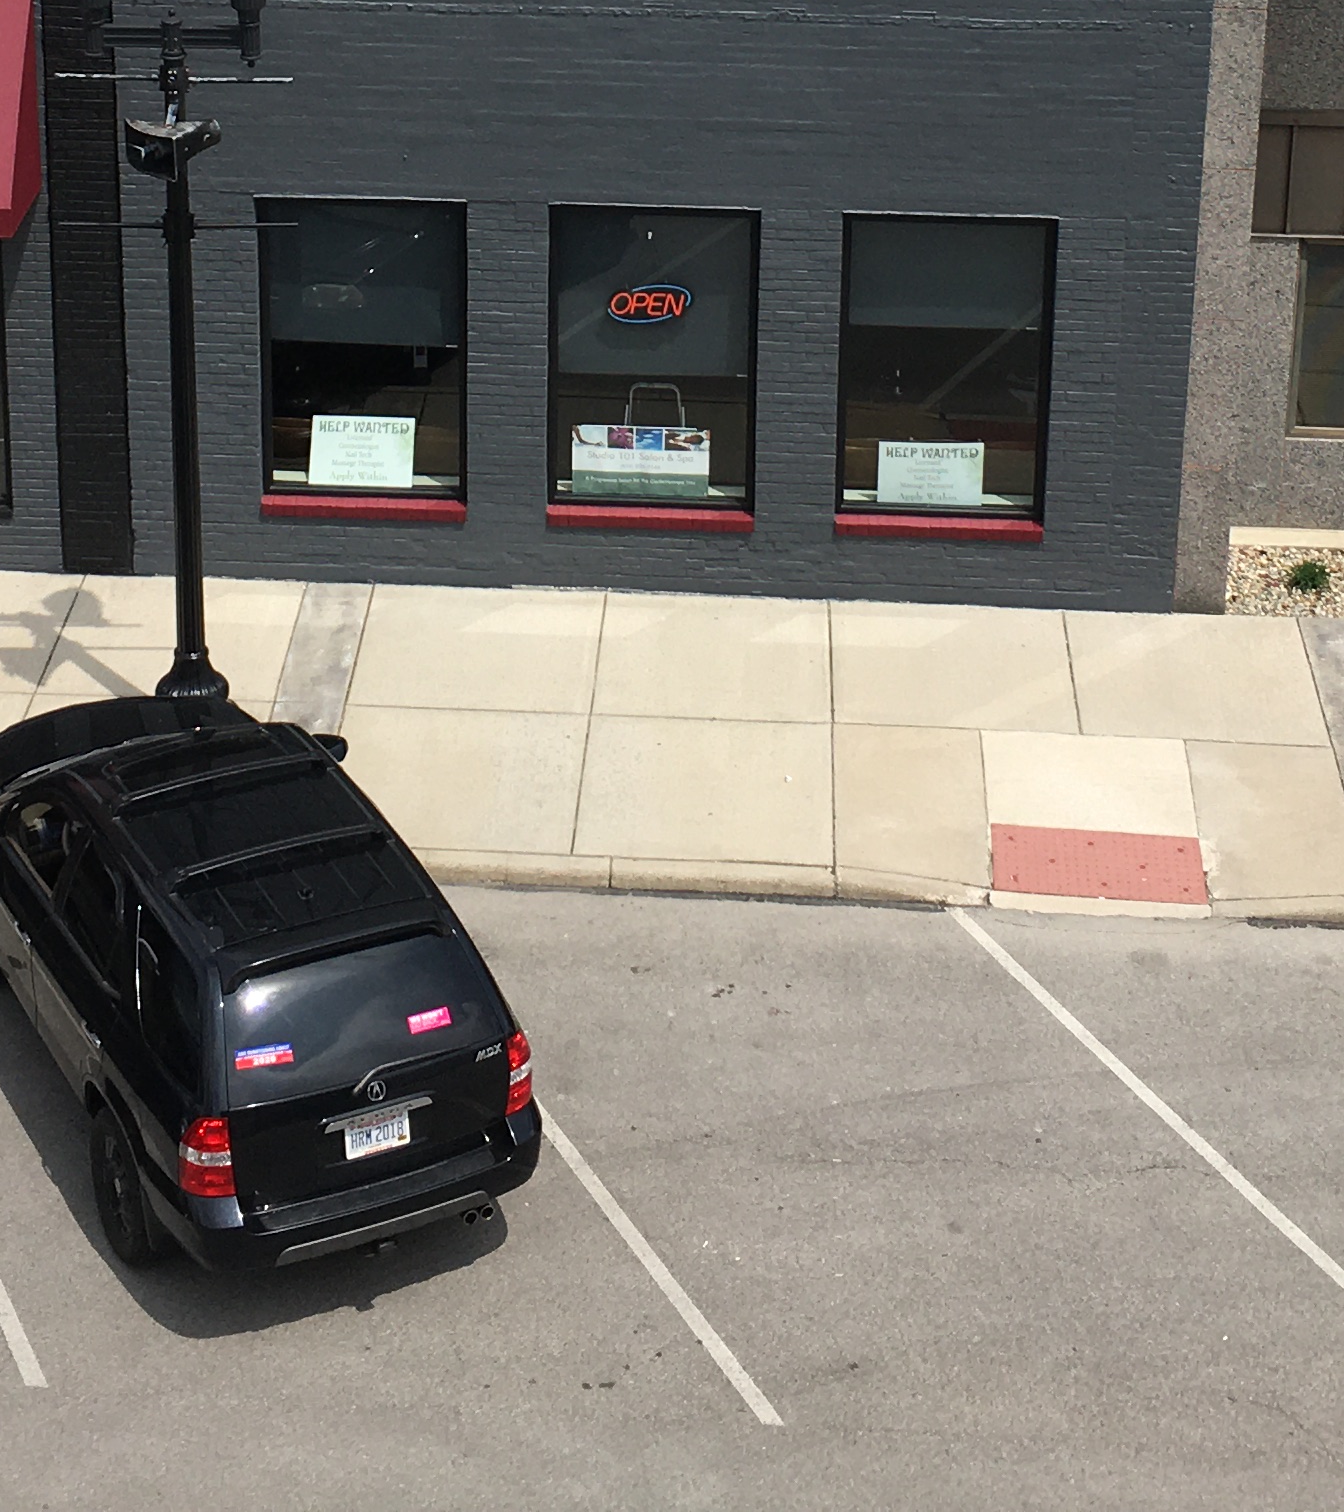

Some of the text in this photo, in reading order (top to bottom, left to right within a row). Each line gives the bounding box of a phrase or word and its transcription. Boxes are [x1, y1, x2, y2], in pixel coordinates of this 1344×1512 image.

[610, 292, 685, 316] OPEN
[319, 420, 410, 435] HELP WANTED
[587, 451, 615, 461] Studio
[638, 452, 665, 462] Salon
[667, 453, 674, 462] &
[677, 454, 694, 464] Spa
[886, 447, 979, 459] HELP WANTED
[475, 1042, 503, 1063] MDX
[350, 1129, 373, 1149] HRM
[375, 1120, 405, 1143] 2018
